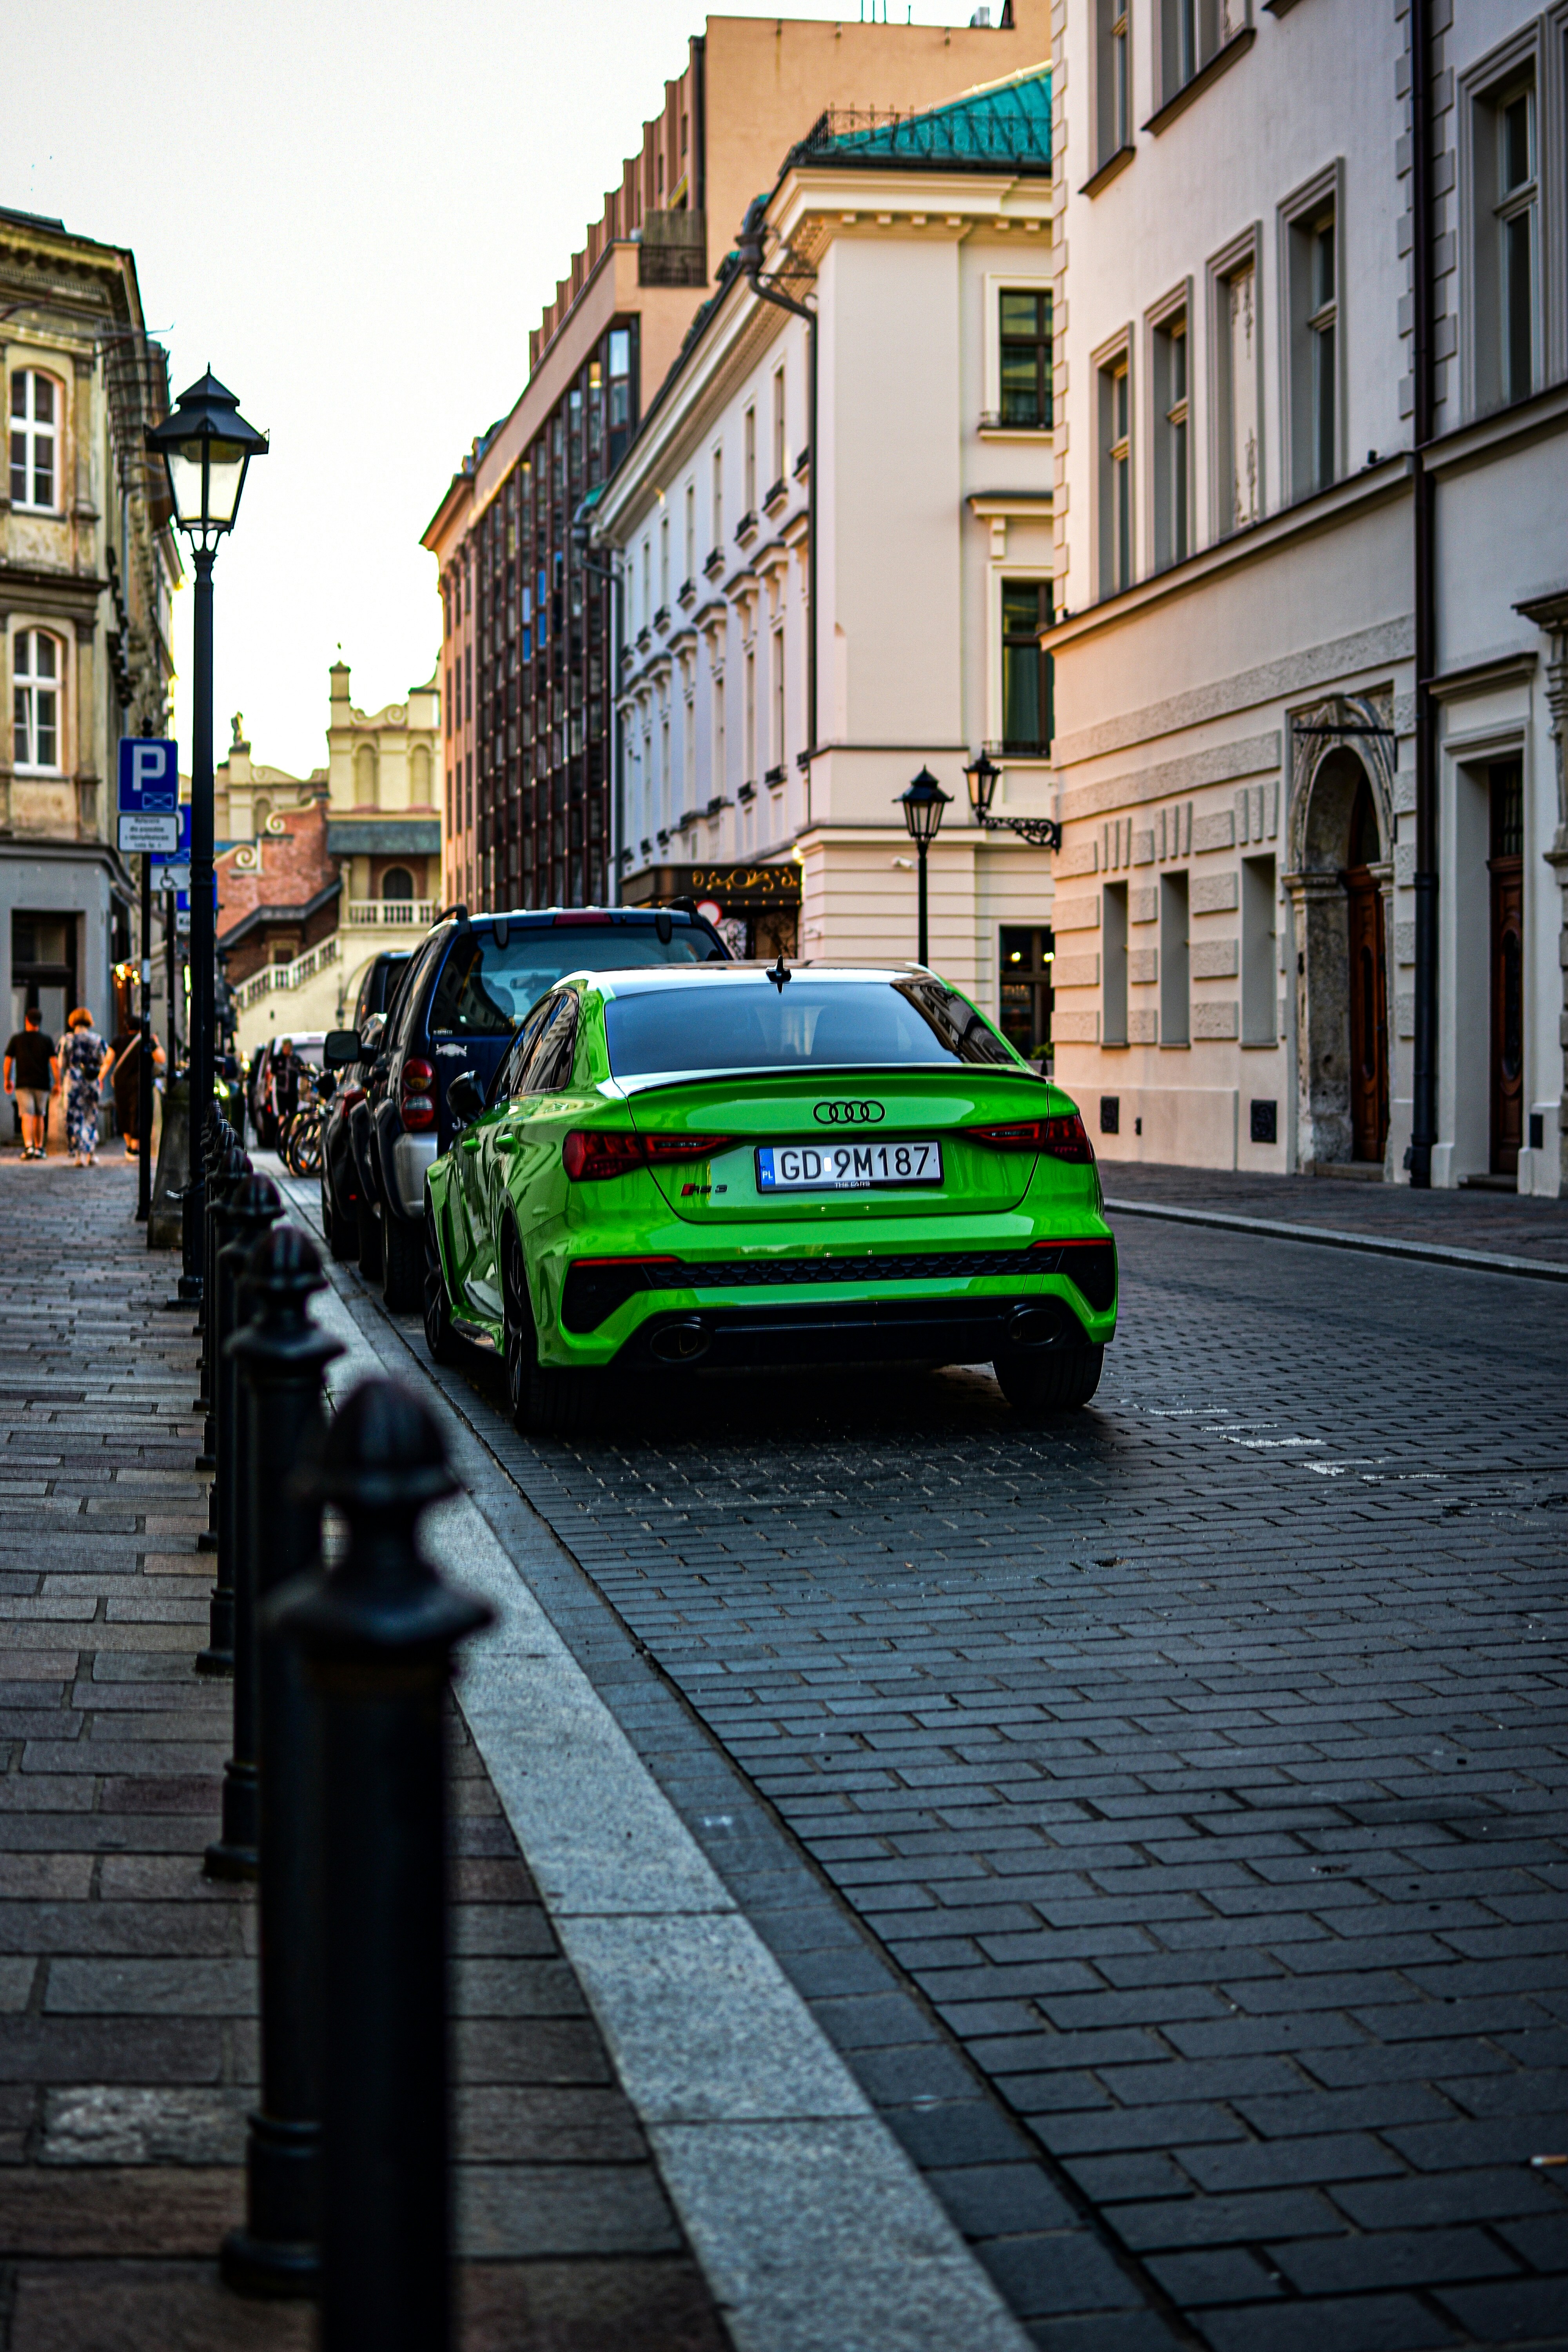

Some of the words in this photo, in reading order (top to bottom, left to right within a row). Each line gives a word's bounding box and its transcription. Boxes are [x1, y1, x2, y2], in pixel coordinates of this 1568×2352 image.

[133, 745, 165, 791] P
[762, 1171, 773, 1180] PL
[781, 1150, 822, 1180] GD
[834, 1146, 929, 1178] 9M187
